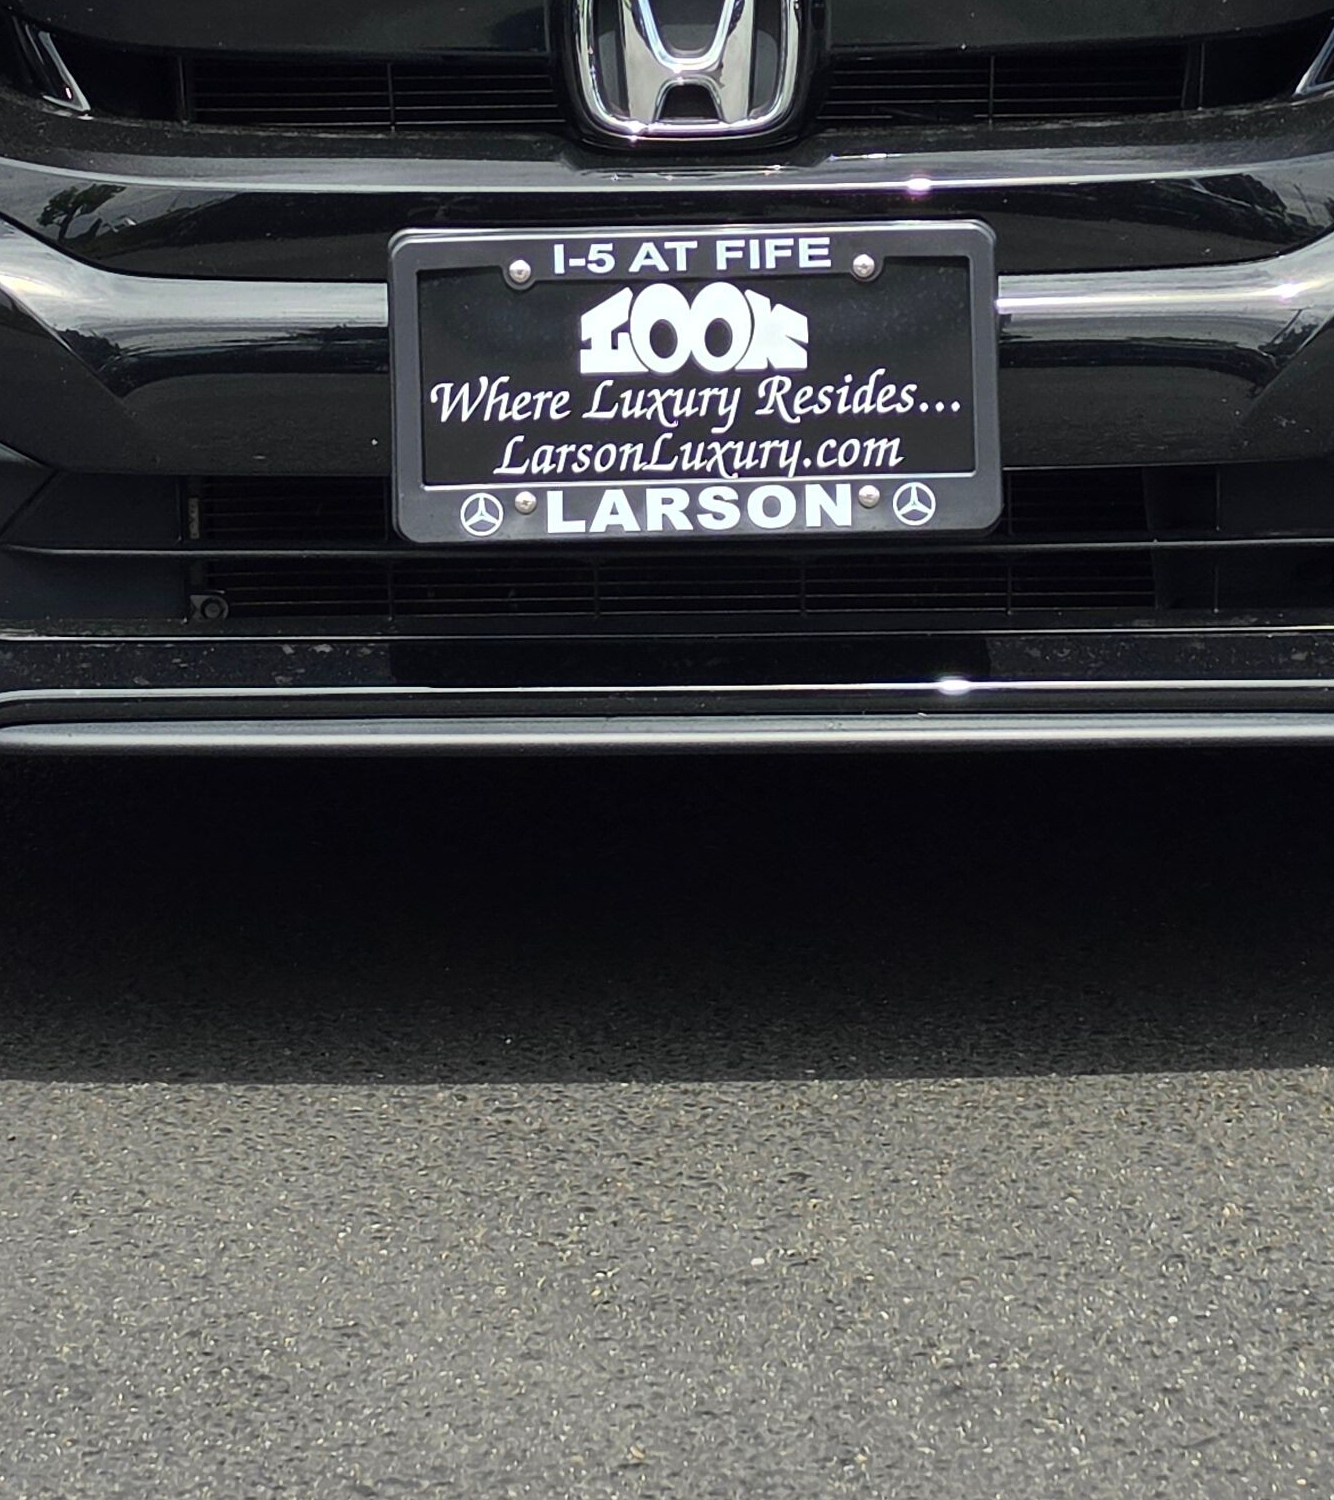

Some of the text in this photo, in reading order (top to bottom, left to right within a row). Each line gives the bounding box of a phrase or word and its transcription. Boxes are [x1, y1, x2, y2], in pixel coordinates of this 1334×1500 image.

[552, 236, 834, 276] I-5 AT FIFE
[580, 281, 809, 375] LOOK
[430, 367, 962, 435] Where Luxury Resides...
[493, 431, 906, 479] LarsonLuxury.com
[545, 483, 855, 536] LARSON
